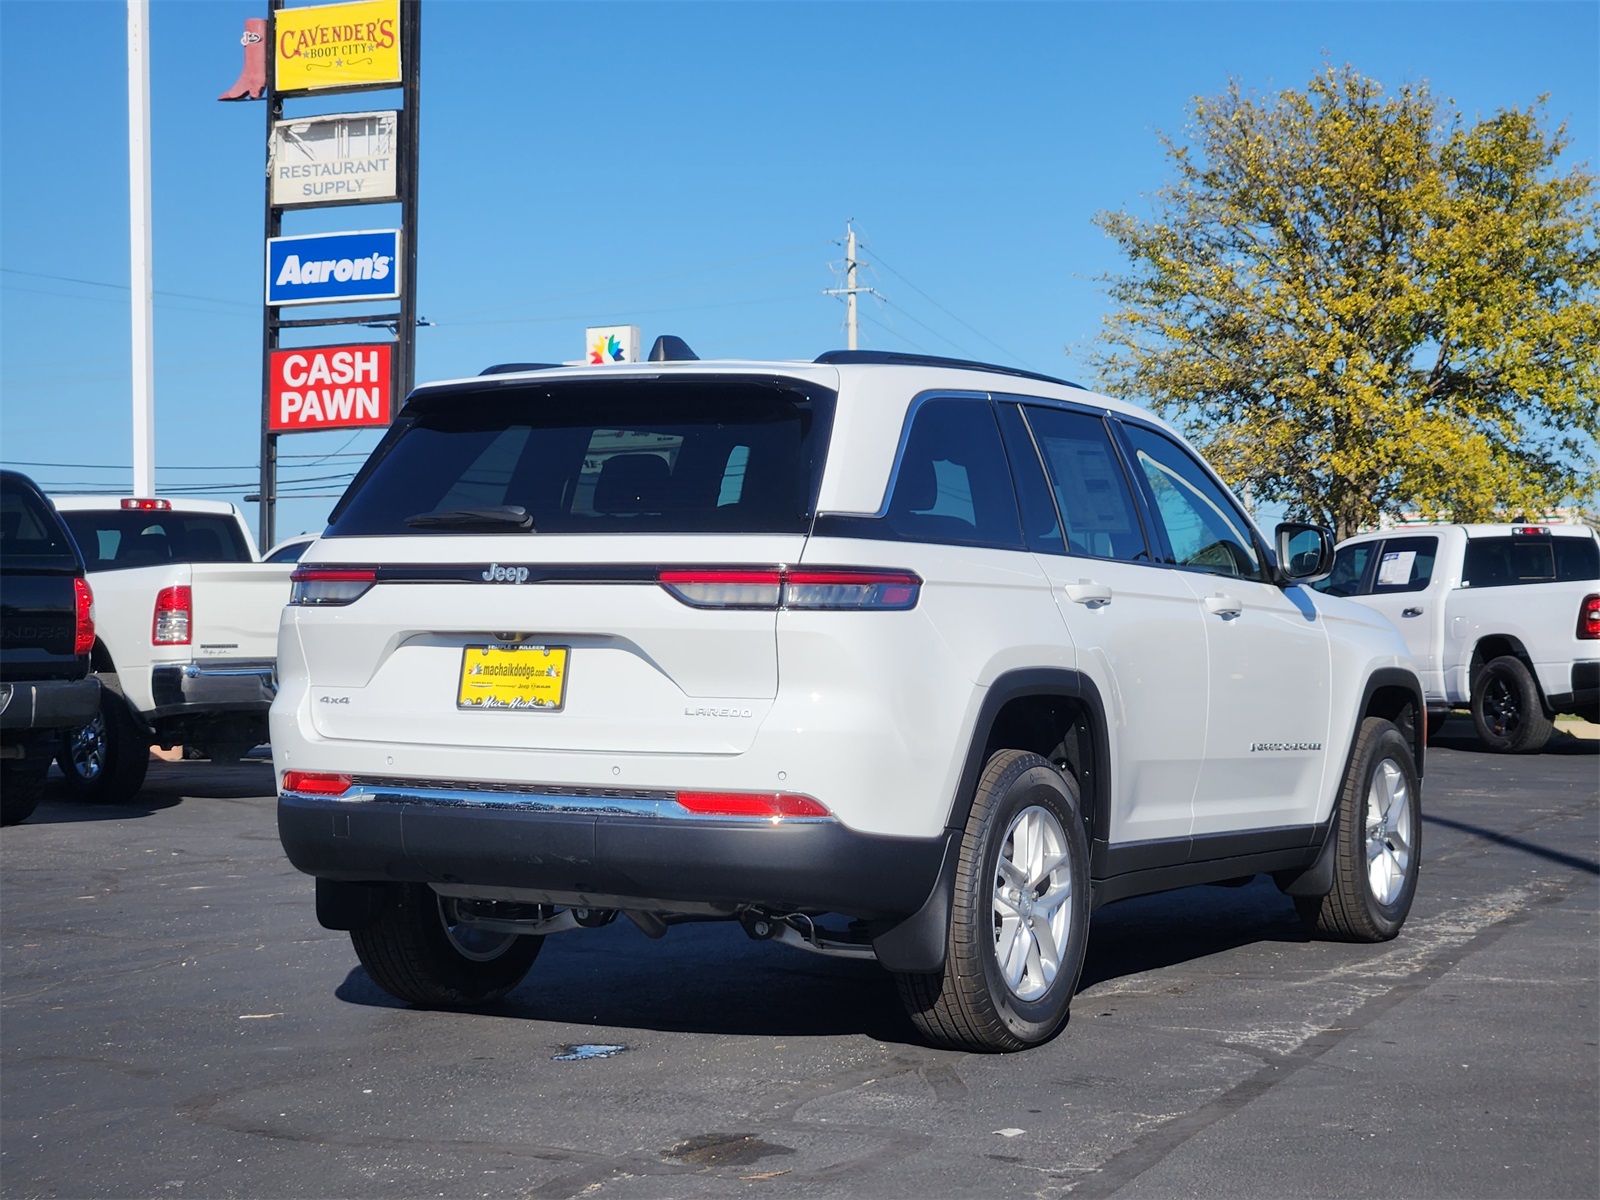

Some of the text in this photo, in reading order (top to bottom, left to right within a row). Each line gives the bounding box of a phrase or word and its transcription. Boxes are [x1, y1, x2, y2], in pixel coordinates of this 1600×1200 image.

[280, 18, 395, 59] CAVENDER'S
[310, 43, 367, 59] BOOT CITY
[280, 158, 389, 179] RESTAURANT
[303, 179, 365, 196] SUPPLY
[276, 252, 390, 286] Aaron's
[283, 351, 378, 387] CASH
[281, 387, 380, 423] PAWN
[482, 563, 529, 584] Jeep
[483, 663, 545, 680] machaikdodge.com
[320, 696, 350, 704] 4x4
[480, 695, 505, 708] Mac
[684, 707, 752, 718] LAREDO
